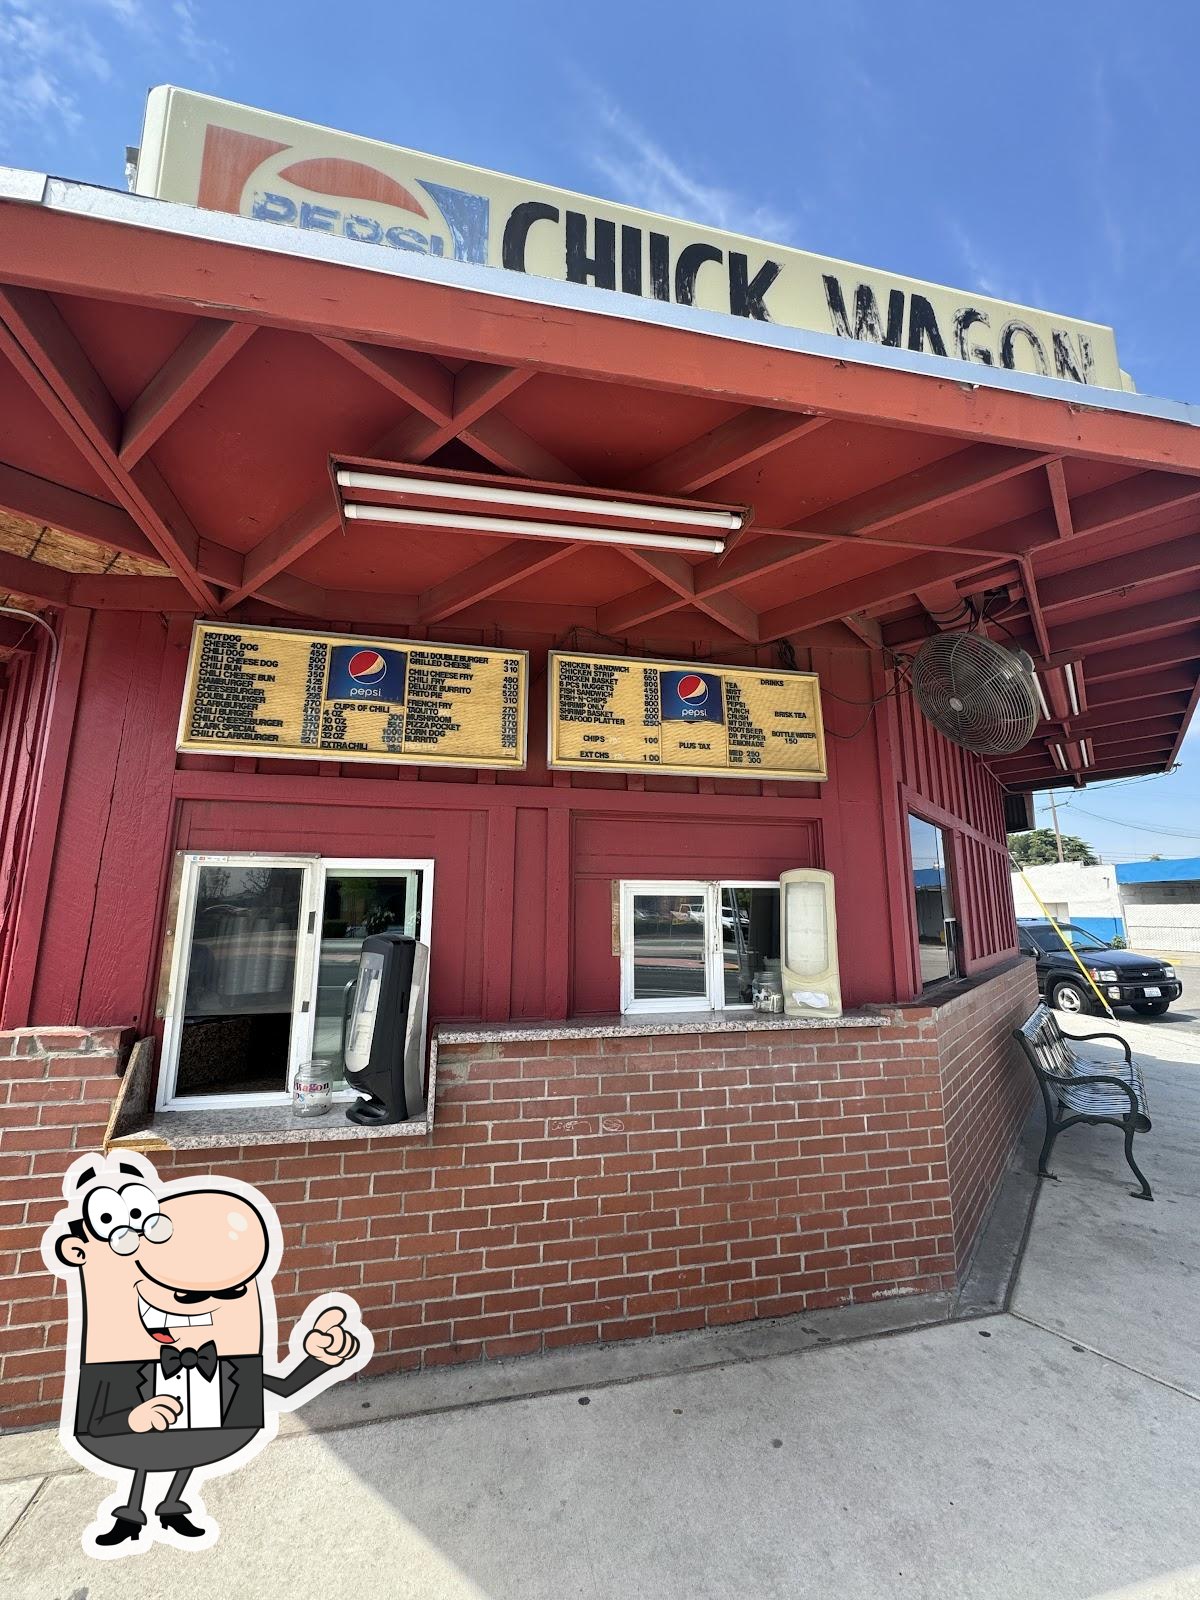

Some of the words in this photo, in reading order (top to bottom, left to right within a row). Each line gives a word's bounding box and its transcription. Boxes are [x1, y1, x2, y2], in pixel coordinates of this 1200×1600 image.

[252, 191, 444, 256] PEPSI
[502, 201, 784, 323] CHUCK
[822, 274, 1096, 384] WAGON
[204, 632, 222, 640] HOT
[223, 634, 241, 642] DOG
[203, 640, 238, 649] CHEESE
[240, 643, 258, 651] DOG
[203, 648, 222, 656] CHILI
[226, 648, 244, 657] DOG
[202, 654, 222, 662] CHILI
[226, 656, 258, 666] CHEESE
[260, 659, 278, 667] DOG
[430, 653, 458, 662] DOUBLE
[460, 656, 488, 664] BURGER
[200, 662, 222, 670] CHILI
[224, 664, 242, 672] BUN
[410, 658, 442, 666] GRILLED
[443, 661, 471, 669] CHEESE
[560, 661, 590, 670] CHICKEN
[594, 664, 630, 673] SANDWICH
[199, 669, 221, 677] CHILI
[224, 670, 256, 680] CHEESE
[258, 674, 275, 682] BUN
[430, 670, 458, 679] CHEESE
[560, 668, 592, 676] CHICKEN
[199, 676, 254, 687] HAMBURGER
[197, 684, 264, 696] CHEESEBURGER
[408, 683, 438, 691] DELUXE
[440, 686, 472, 694] BURRITO
[582, 683, 614, 691] NUGGETS
[350, 688, 380, 697] pepsi
[577, 689, 613, 698] SANDWICH
[197, 692, 231, 700] DOUBLE
[232, 694, 266, 704] BURGER
[334, 703, 356, 711] CUPS
[408, 700, 438, 708] FRENCH
[219, 709, 254, 718] BURGER
[408, 707, 438, 715] TAQUITO
[682, 708, 707, 716] pepsi
[193, 714, 216, 722] CHILI
[217, 716, 284, 727] CHEESEBURGER
[406, 714, 452, 723] MUSHROOM
[222, 724, 258, 732] SPECIAL
[430, 723, 460, 731] POCKET
[405, 728, 427, 736] CORN
[405, 735, 438, 743] BURRITO
[322, 741, 348, 749] EXTRA
